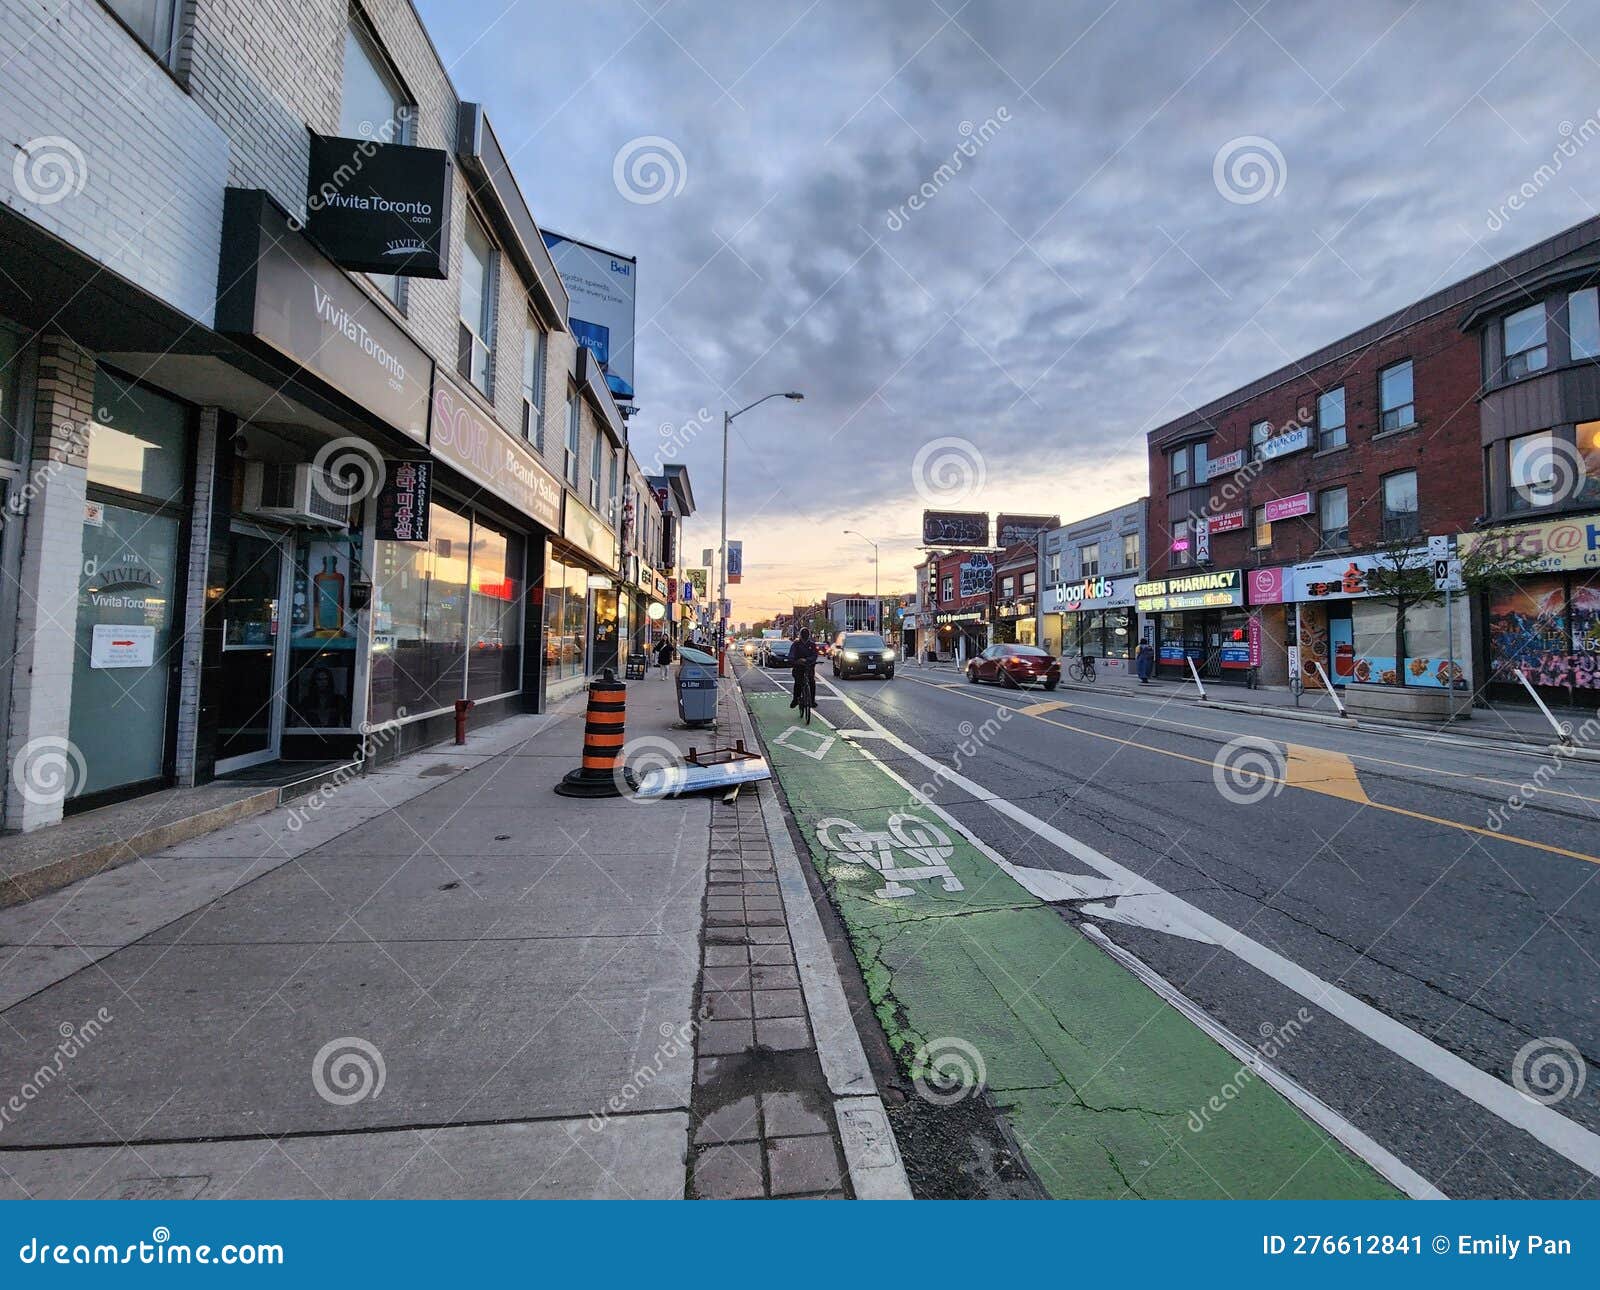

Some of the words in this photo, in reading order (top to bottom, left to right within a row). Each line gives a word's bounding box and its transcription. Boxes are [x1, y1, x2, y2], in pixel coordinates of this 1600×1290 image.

[323, 191, 432, 215] VivitaToronto
[386, 239, 426, 249] VIVITA
[610, 260, 630, 277] Bell
[313, 285, 405, 381] VivitaToronto
[506, 449, 540, 497] Beauty
[101, 568, 151, 584] VIVITA
[1135, 581, 1166, 597] GREEN
[1169, 572, 1235, 593] PHARMACY
[1056, 577, 1113, 602] bloorkids
